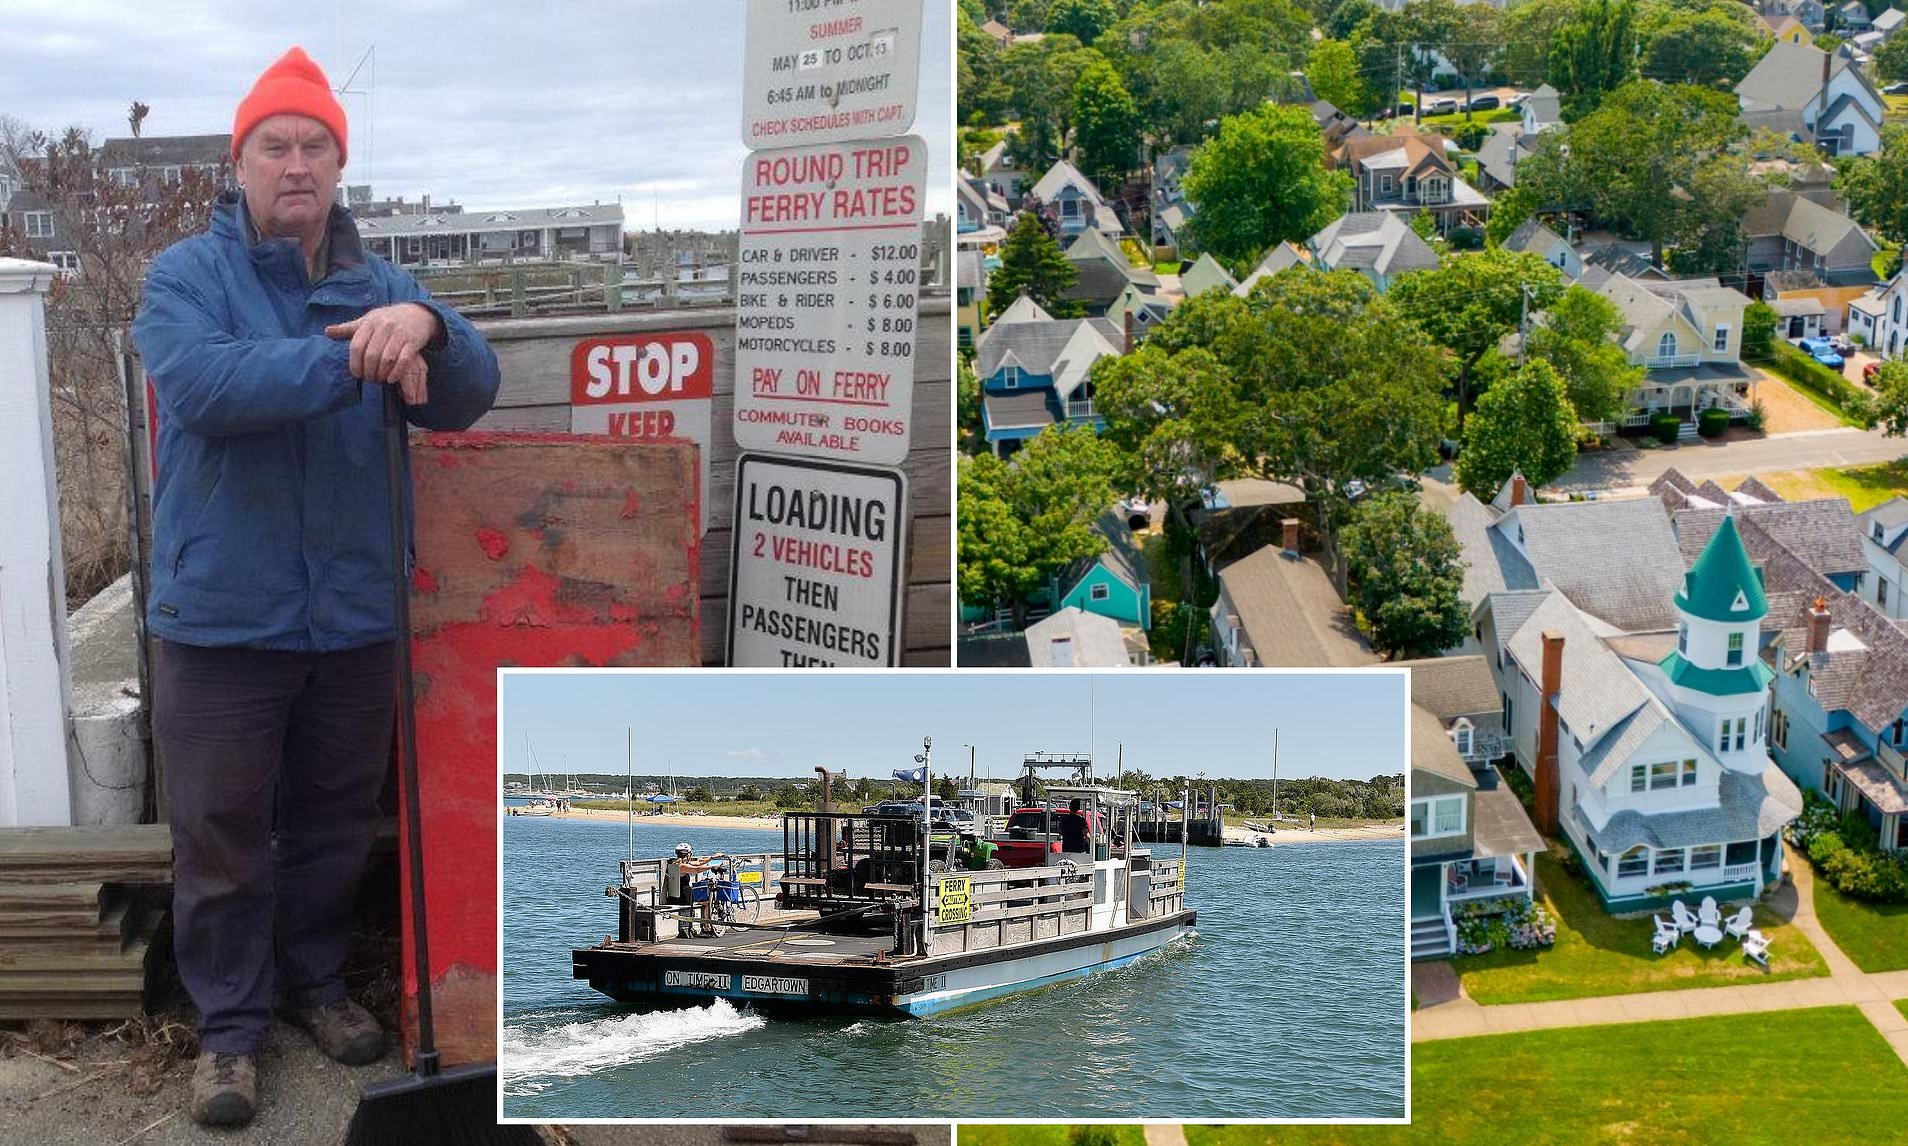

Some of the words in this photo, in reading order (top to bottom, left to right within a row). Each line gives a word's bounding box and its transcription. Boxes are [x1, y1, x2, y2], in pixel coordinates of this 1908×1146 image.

[810, 16, 862, 40] SUMMER
[772, 54, 799, 72] MAY
[825, 48, 841, 64] TO
[767, 87, 793, 104] 6:45
[796, 85, 815, 100] AM
[820, 84, 832, 98] to
[836, 73, 891, 97] MIDNIGHT
[752, 119, 788, 137] CHECK
[790, 112, 850, 132] SCHEDULES
[852, 109, 876, 125] WITH
[756, 153, 843, 187] ROUND
[852, 146, 910, 179] TRIP
[747, 193, 825, 223] FERRY
[833, 185, 916, 218] RATES
[742, 249, 768, 263] CAR
[774, 249, 782, 262] &
[790, 248, 839, 262] DRIVER
[872, 244, 918, 261] $12.00
[740, 271, 838, 286] PASSENGERS
[870, 270, 878, 285] $
[884, 269, 916, 284] 4.00
[740, 293, 767, 308] BIKE
[778, 294, 788, 307] &
[795, 293, 834, 308] RIDER
[868, 294, 877, 309] $
[884, 294, 915, 309] 6.00
[739, 316, 796, 330] MOPEDS
[867, 317, 876, 333] $
[882, 318, 913, 333] 8.00
[738, 338, 836, 354] MOTORCYCLES
[866, 342, 874, 356] $
[881, 342, 911, 357] 8.00
[585, 342, 699, 399] STOP
[753, 368, 783, 393] PAY
[797, 370, 820, 396] ON
[833, 371, 891, 401] FERRY
[738, 409, 830, 428] COMMUTER
[844, 416, 904, 435] BOOKS
[776, 430, 861, 451] AVAILABLE
[749, 482, 886, 542] LOADING
[752, 532, 766, 558] 2
[772, 534, 874, 578] VEHICLES
[784, 576, 838, 612] THEN
[742, 604, 880, 660] PASSENGERS
[780, 650, 836, 667] TH
[945, 879, 966, 893] FERRY
[941, 906, 969, 921] CROSSING
[666, 971, 680, 985] ON
[688, 973, 709, 987] TIME
[744, 976, 806, 993] EDGARTOWN
